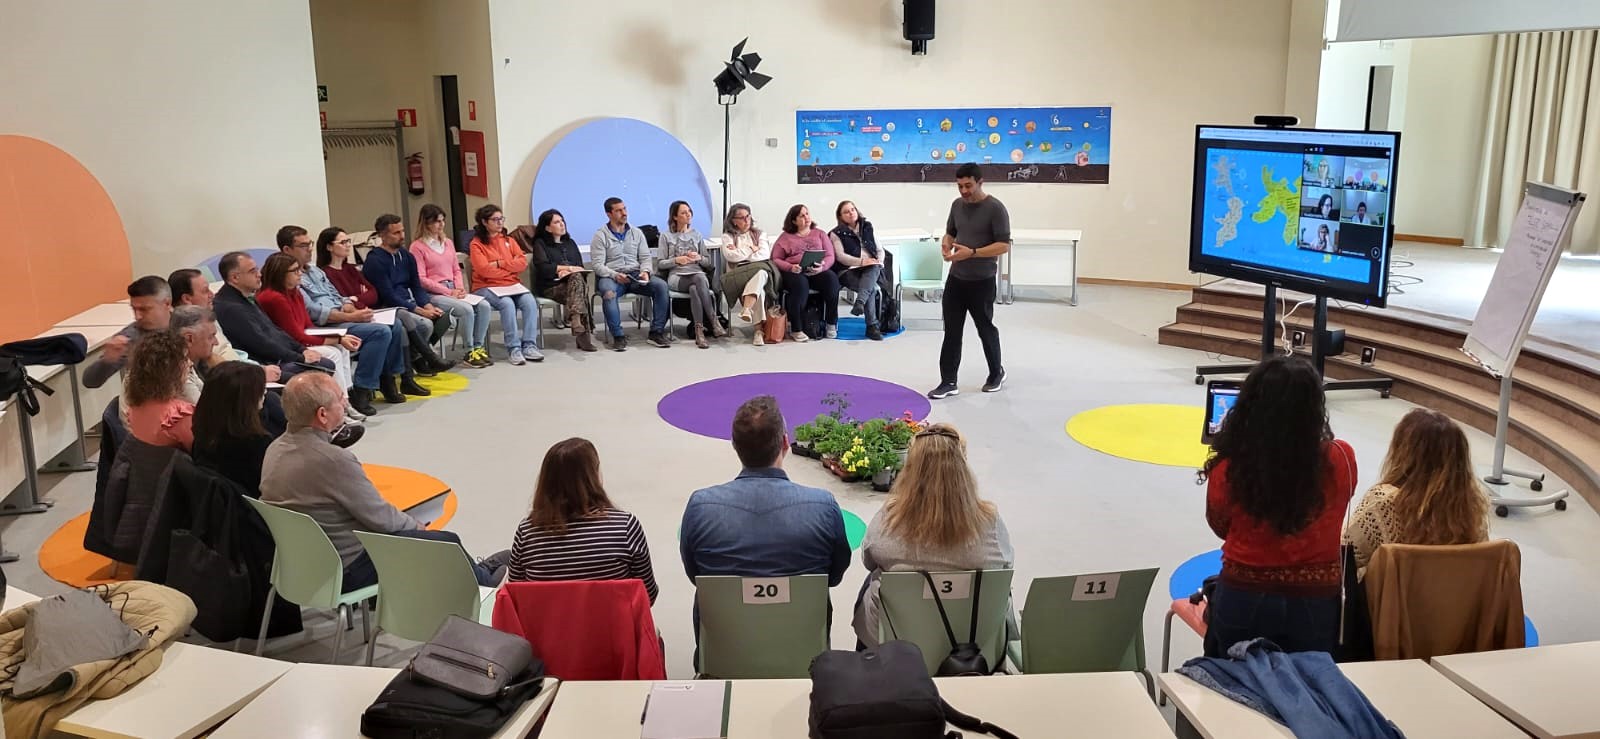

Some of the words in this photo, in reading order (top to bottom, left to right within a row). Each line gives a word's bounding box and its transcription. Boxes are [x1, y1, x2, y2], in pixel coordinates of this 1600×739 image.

[917, 118, 923, 128] 3
[1012, 119, 1018, 127] 5
[804, 129, 810, 138] 1
[753, 584, 778, 597] 20
[941, 580, 953, 593] 3
[1084, 581, 1107, 594] 11
